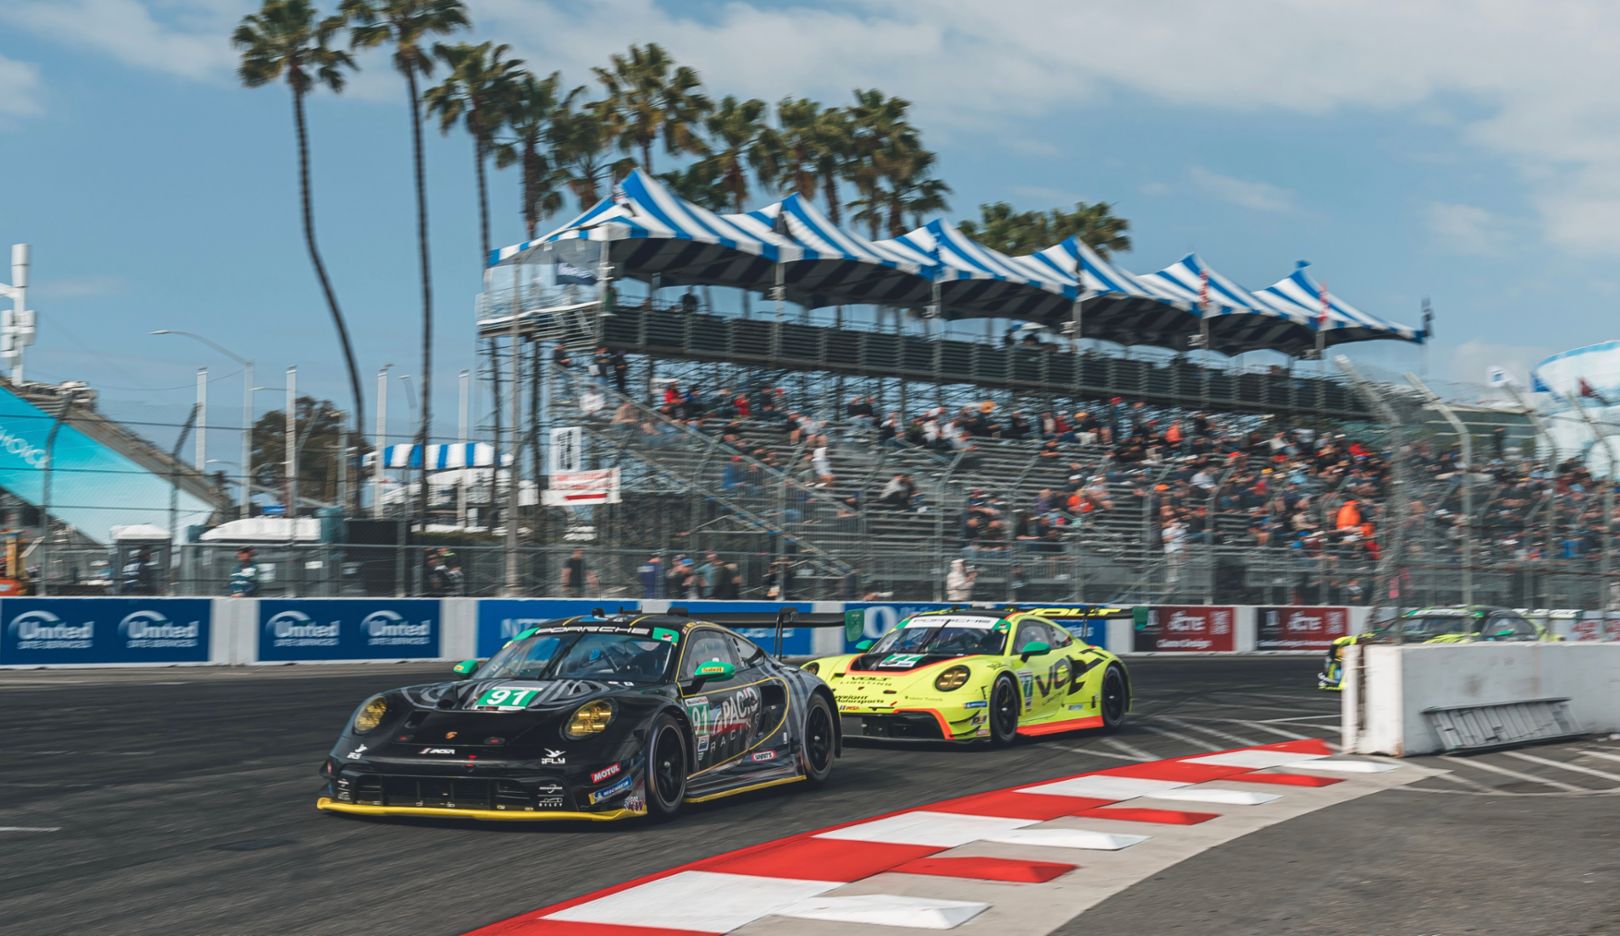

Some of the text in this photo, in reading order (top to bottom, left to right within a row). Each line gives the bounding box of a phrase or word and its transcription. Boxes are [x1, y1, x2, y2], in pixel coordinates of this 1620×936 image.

[18, 620, 95, 639] United
[128, 620, 200, 638] United
[274, 620, 341, 638] United
[368, 619, 431, 636] United
[535, 626, 650, 636] PORSCHE
[485, 689, 529, 706] 91
[691, 704, 708, 736] 91
[593, 764, 621, 781] MOTUL
